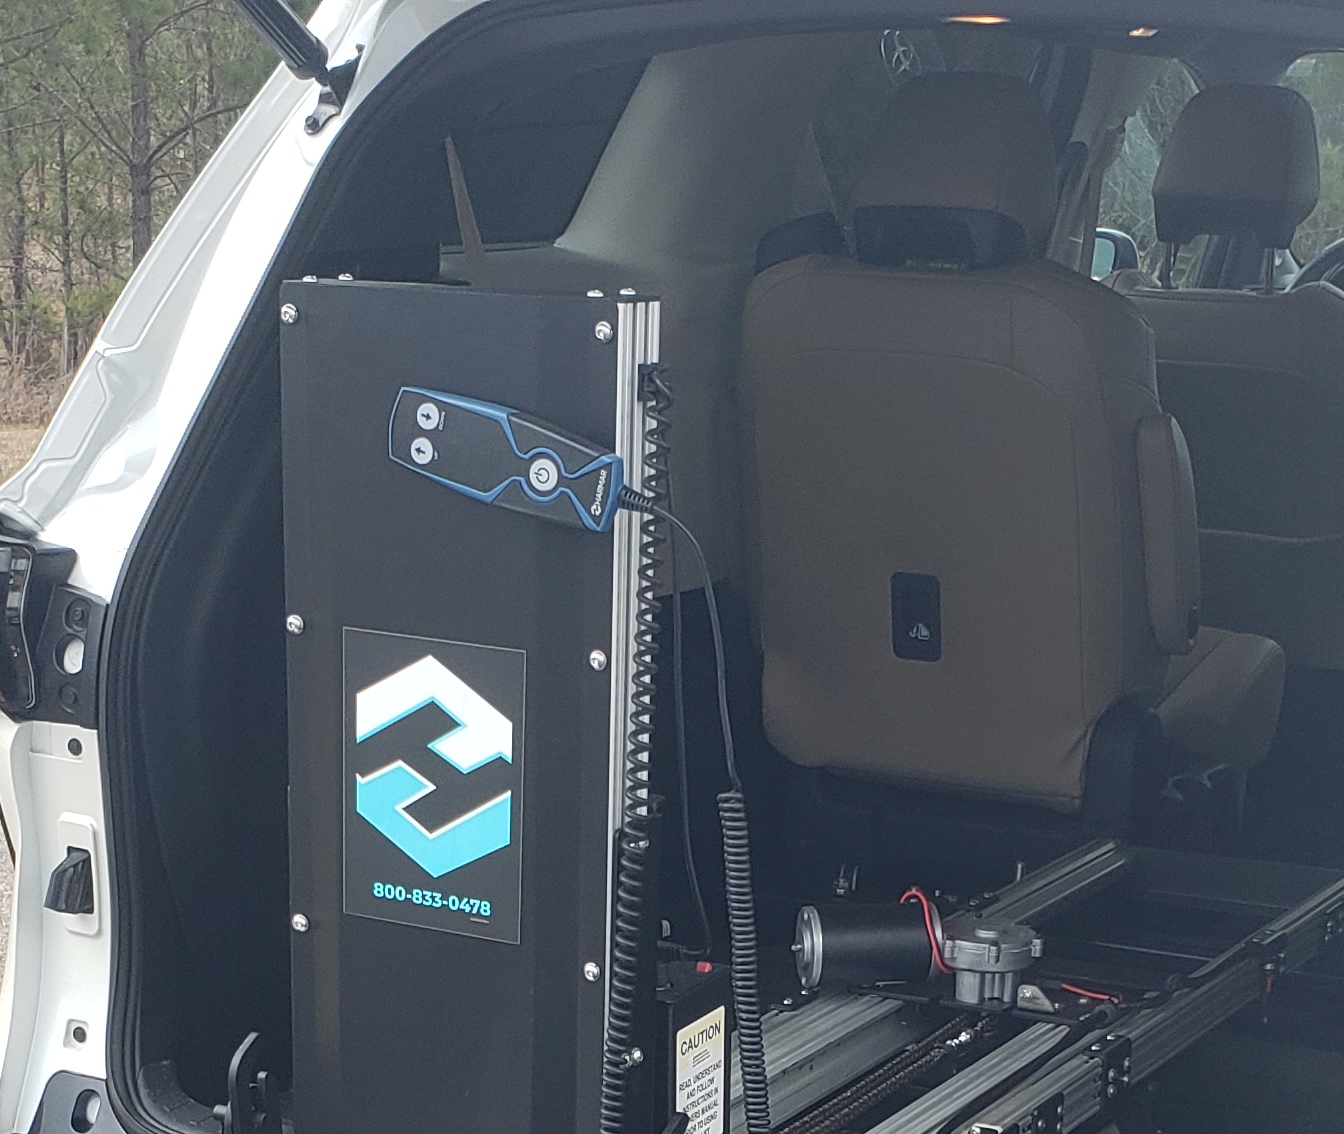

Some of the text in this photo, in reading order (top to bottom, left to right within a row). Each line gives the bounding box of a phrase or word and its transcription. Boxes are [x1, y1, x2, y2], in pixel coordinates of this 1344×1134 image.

[594, 469, 607, 506] HARMAR
[373, 882, 491, 917] 800-833-0478
[680, 1020, 721, 1056] CAUTION
[693, 1060, 722, 1085] UNDERSTAND
[686, 1076, 715, 1100] AND FOLLOW
[713, 1086, 719, 1096] IN
[701, 1099, 719, 1115] MANUAL
[697, 1119, 704, 1130] TO
[704, 1111, 718, 1126] USING
